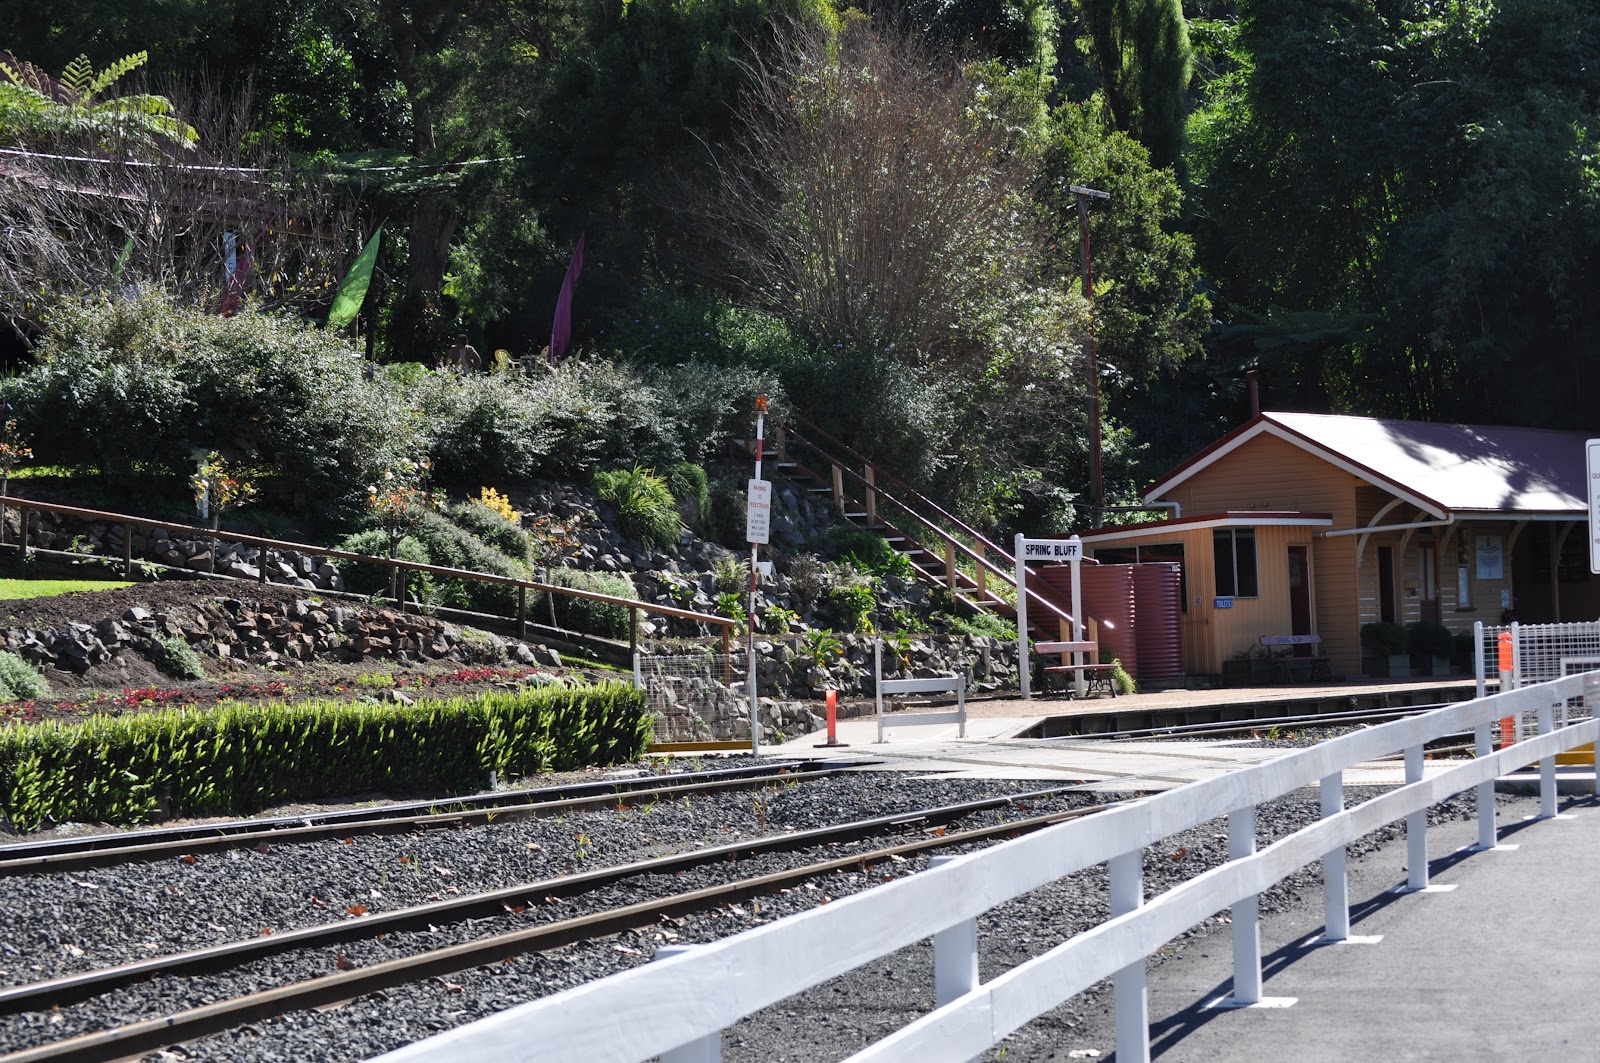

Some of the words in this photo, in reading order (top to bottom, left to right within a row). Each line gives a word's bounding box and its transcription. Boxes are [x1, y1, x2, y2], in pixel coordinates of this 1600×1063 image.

[1025, 544, 1051, 556] SPRING
[1054, 545, 1078, 556] BLUFF
[1216, 600, 1231, 608] TOILETS
